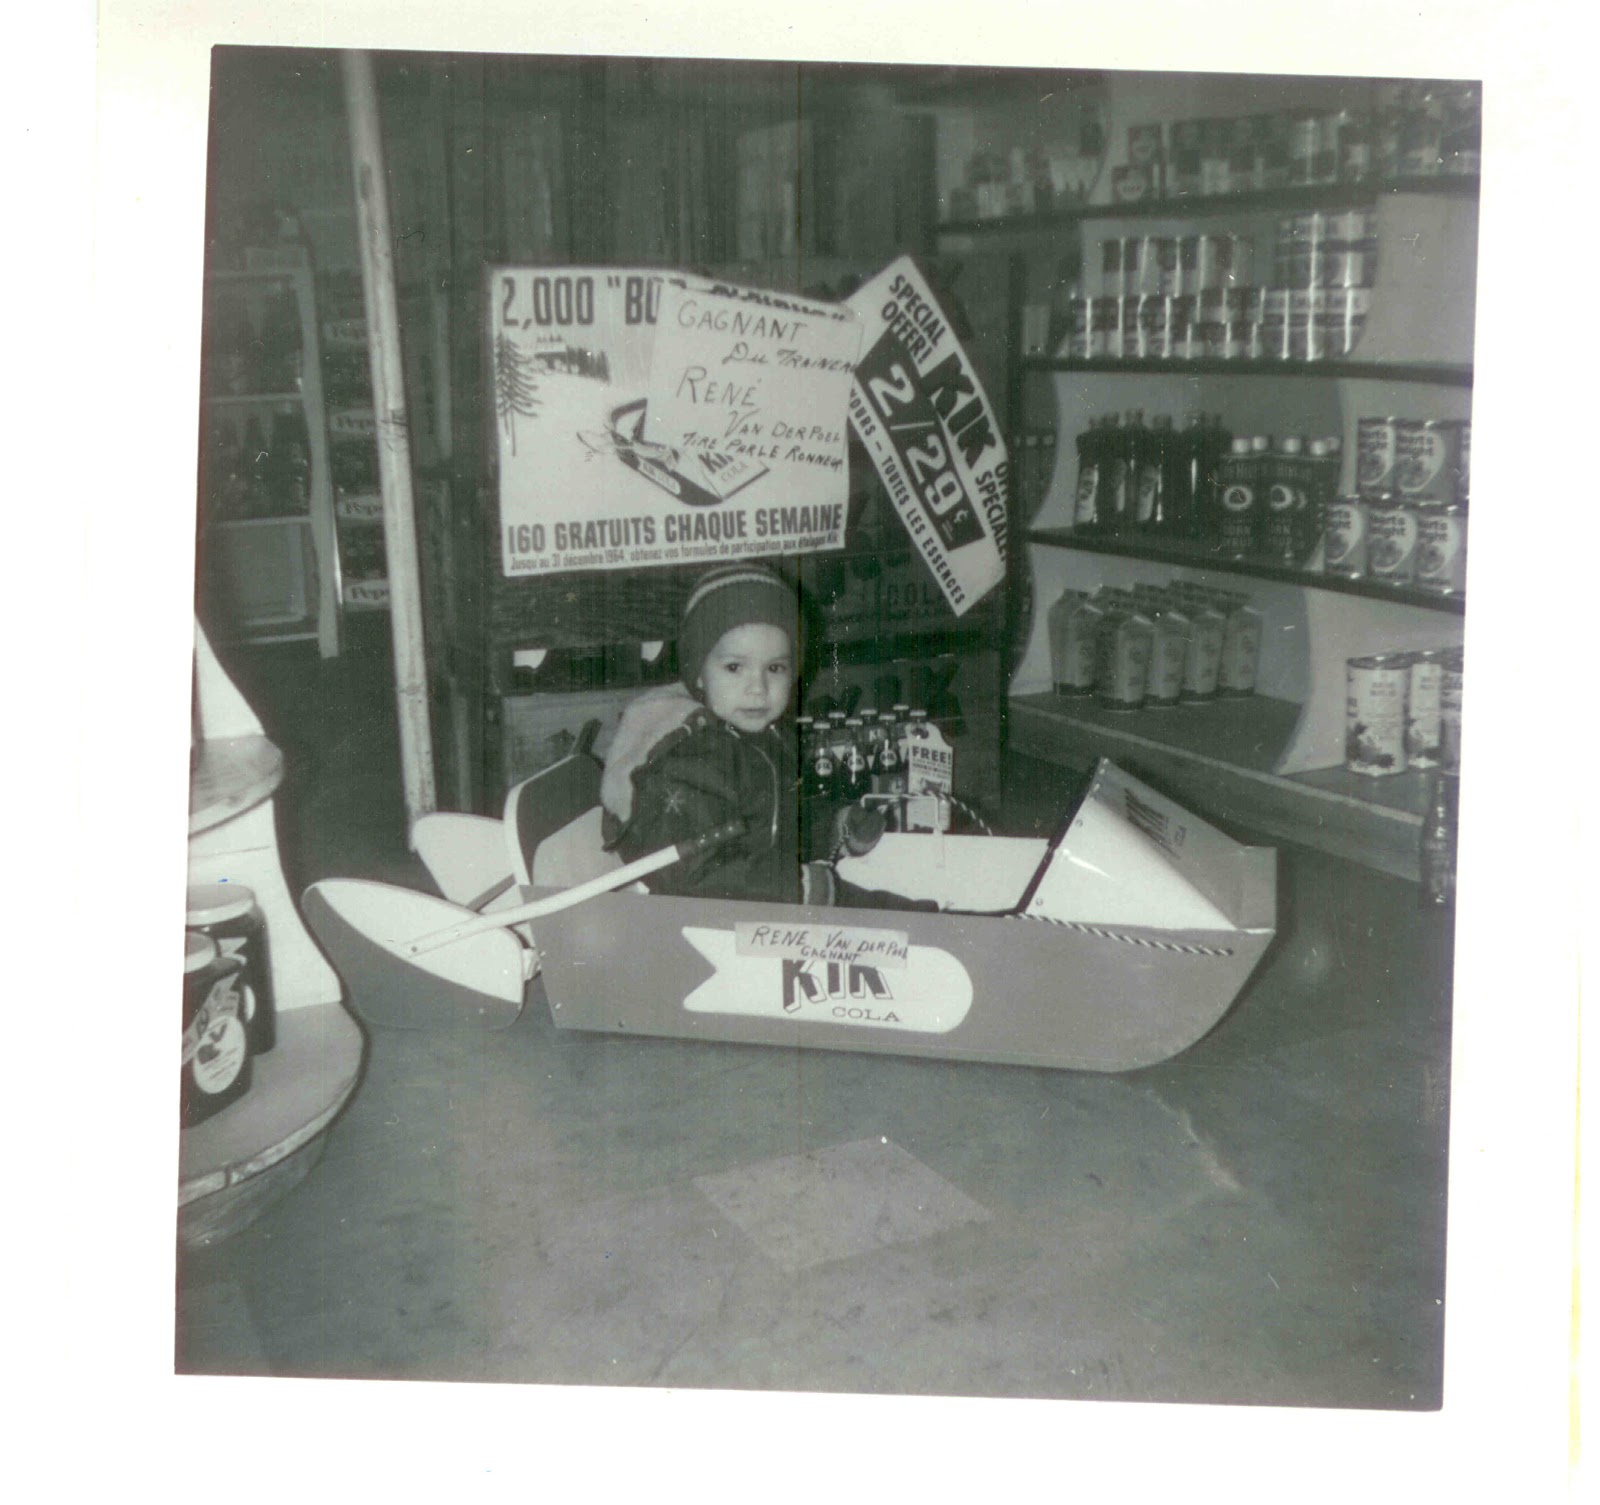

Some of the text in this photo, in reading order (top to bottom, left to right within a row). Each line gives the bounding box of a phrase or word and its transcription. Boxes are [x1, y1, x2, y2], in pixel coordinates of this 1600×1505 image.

[502, 275, 594, 330] 2,000
[677, 299, 808, 343] GAGNANT
[889, 274, 946, 347] SPECIAL
[881, 300, 934, 364] OFFER!
[920, 351, 997, 471] KIK
[508, 503, 843, 554] 160 GRATUITS CHAQUE SEMAINE
[719, 542, 730, 555] de
[880, 456, 909, 504] TOUTES
[906, 508, 926, 535] LES
[922, 537, 966, 606] ESSENCES
[911, 745, 952, 765] FREE!
[800, 945, 862, 964] GAGNANT
[825, 928, 851, 951] VAN
[831, 1006, 901, 1023] COLA
